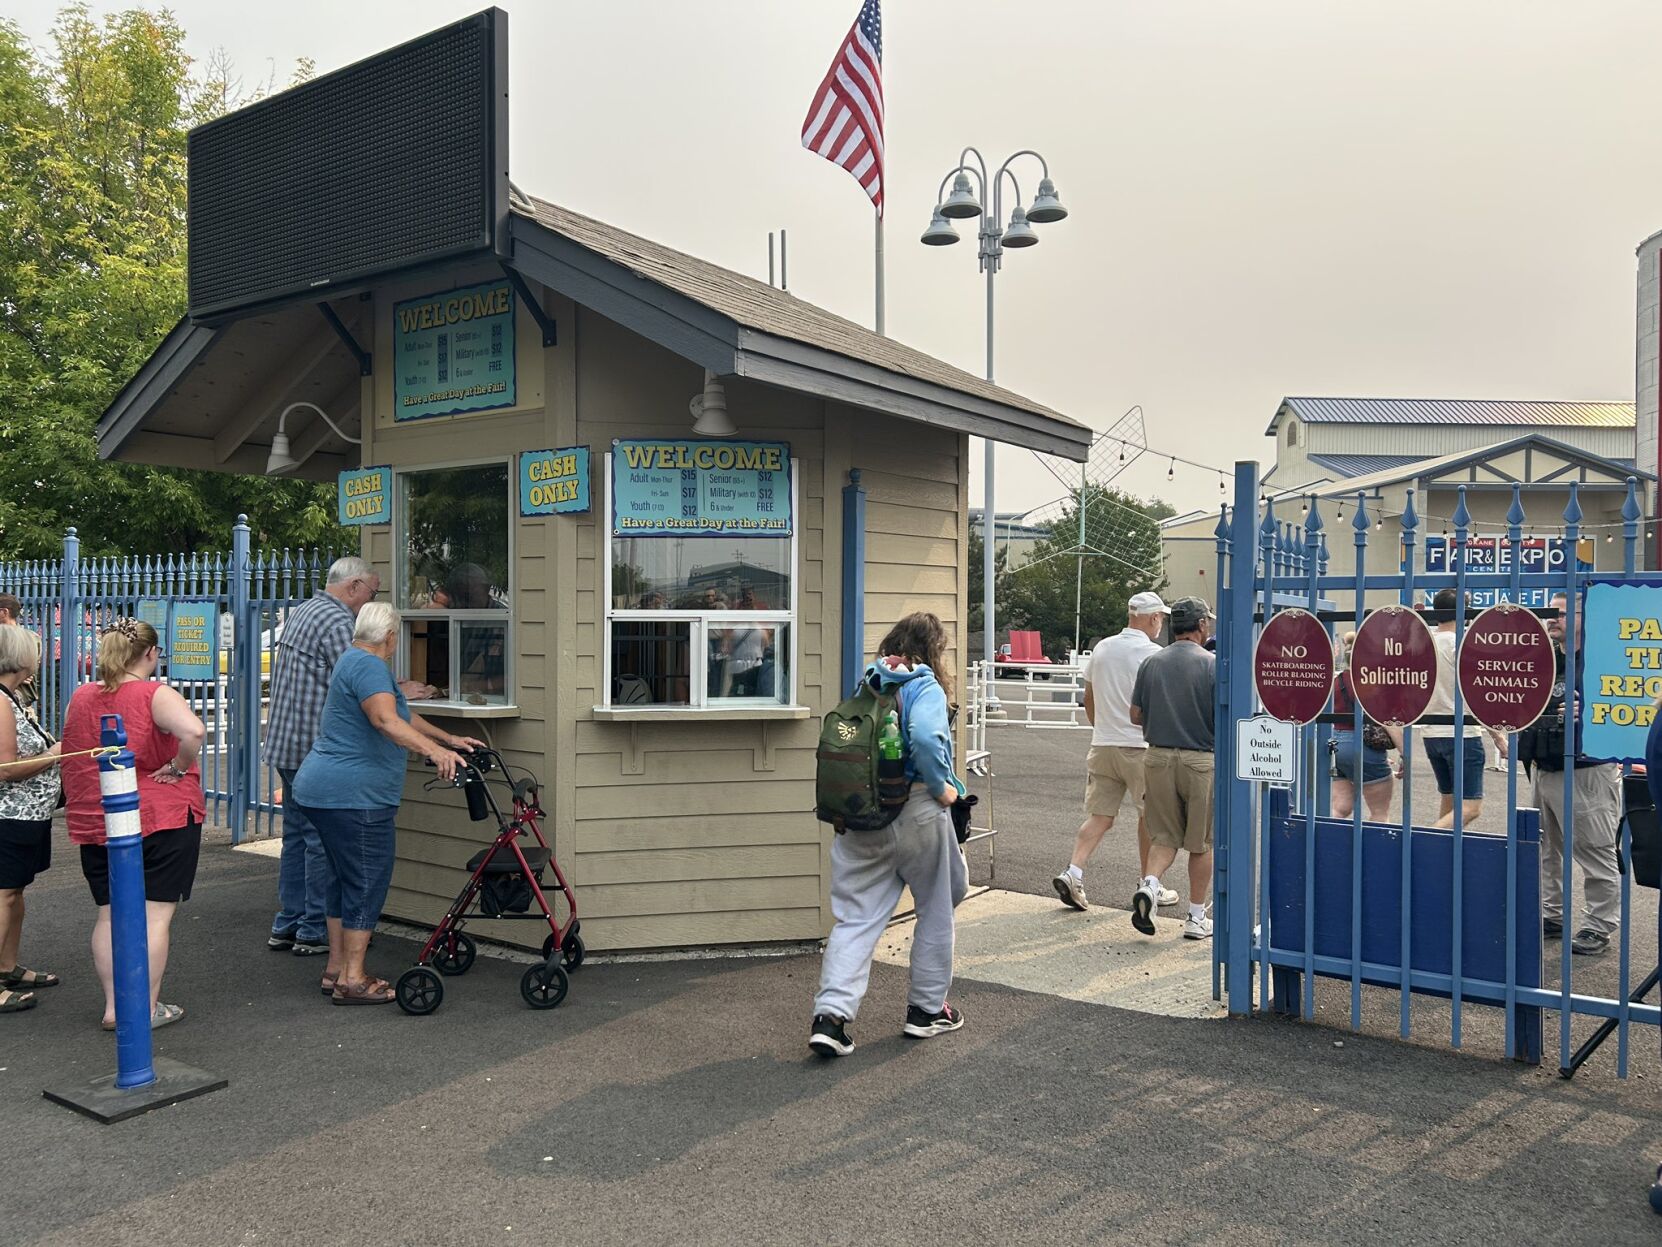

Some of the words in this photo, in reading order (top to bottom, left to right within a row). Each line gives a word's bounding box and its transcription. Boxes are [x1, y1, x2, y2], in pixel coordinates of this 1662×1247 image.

[400, 287, 510, 334] WELCOME
[491, 343, 502, 354] $12
[488, 360, 502, 372] FREE
[403, 395, 422, 407] Have
[428, 391, 448, 403] Great
[448, 388, 464, 400] Day
[465, 387, 473, 397] at
[473, 385, 487, 396] the
[487, 381, 507, 393] Fair!
[623, 446, 783, 471] WELCOME
[528, 454, 577, 483] CASH
[629, 473, 648, 483] Adult
[681, 469, 696, 481] $15
[709, 473, 732, 484] Senior
[758, 470, 773, 482] $12
[345, 473, 382, 497] CASH
[529, 479, 580, 507] ONLY
[682, 487, 696, 499] $17
[710, 487, 736, 500] Military
[758, 488, 773, 500] $12
[345, 495, 384, 519] ONLY
[630, 500, 650, 511] Youth
[682, 504, 696, 517] $12
[710, 503, 715, 511] 6
[756, 502, 774, 512] FREE
[622, 517, 653, 528] Have
[656, 519, 662, 528] a
[665, 517, 699, 529] Great
[700, 518, 724, 530] Day
[726, 519, 738, 529] at
[739, 518, 759, 529] the
[760, 518, 786, 529] Fair!
[1485, 549, 1493, 564] &
[1501, 549, 1564, 565] EXPO
[176, 617, 192, 626] PASS
[193, 617, 205, 626] OR
[177, 629, 203, 639] TICKET
[1474, 632, 1539, 646] NOTICE
[174, 642, 209, 652] REQUIRED
[1281, 645, 1308, 658] NO
[1384, 637, 1403, 656] No
[172, 655, 186, 664] FOR
[187, 655, 211, 665] ENTRY
[1262, 662, 1326, 670] SKATEBOARDING
[1477, 660, 1535, 672] SERVICE
[1261, 670, 1289, 678] ROLLER
[1291, 671, 1326, 680] BLADING
[1360, 666, 1428, 689] Soliciting
[1263, 679, 1294, 687] BICYCLE
[1295, 680, 1324, 688] RIDING
[1472, 675, 1539, 689] ANIMALS
[1484, 691, 1525, 704] ONLY
[1592, 703, 1658, 727] FOR
[1259, 725, 1272, 734] No
[1250, 738, 1282, 749] Outside
[1250, 752, 1282, 763] Alcohol
[1249, 767, 1282, 778] Allowed
